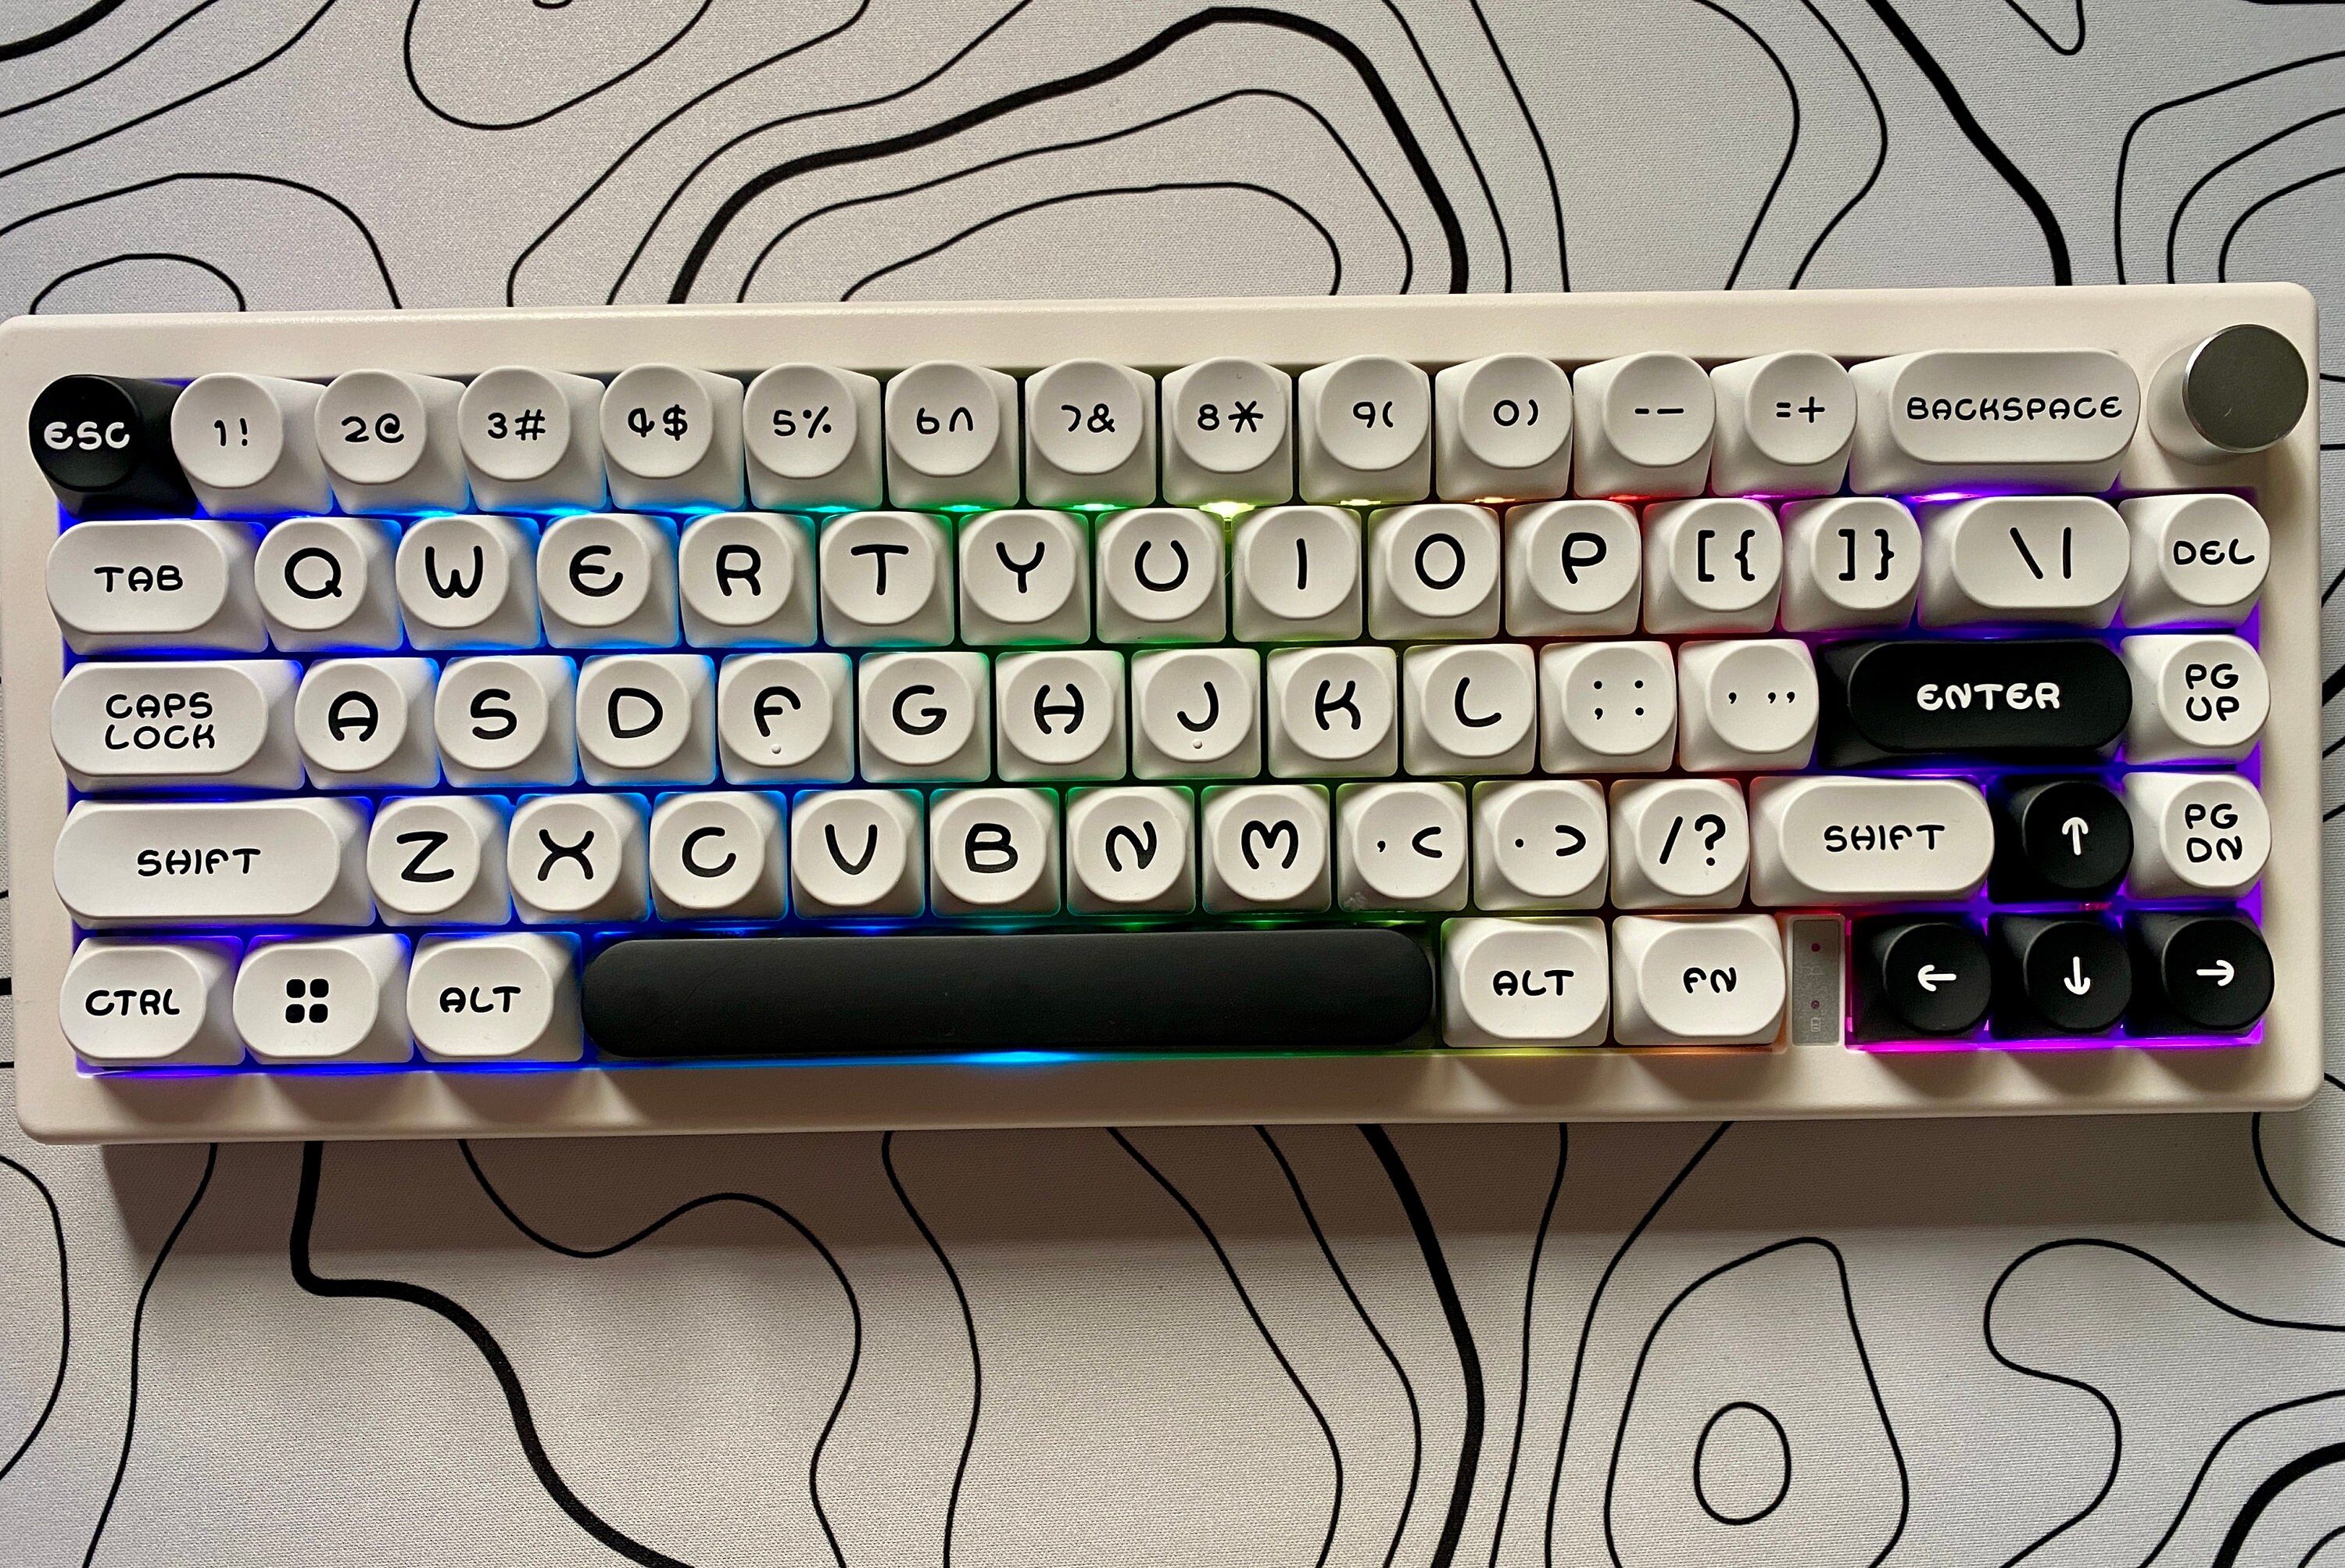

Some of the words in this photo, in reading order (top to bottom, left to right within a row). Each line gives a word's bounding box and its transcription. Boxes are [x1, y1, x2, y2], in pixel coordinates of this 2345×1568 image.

[341, 413, 405, 444] 2@
[487, 409, 546, 441] 3#
[628, 403, 688, 442] 4$
[772, 406, 832, 439] 5%
[1906, 396, 2122, 421] BACKSPACE
[44, 421, 131, 450] ESC
[284, 547, 342, 600] Q
[424, 545, 484, 599] W
[569, 545, 624, 597] E
[716, 544, 761, 596] R
[850, 543, 909, 596] T
[995, 541, 1045, 594] Y
[1134, 539, 1189, 592] U
[1414, 532, 1466, 590] O
[1561, 532, 1607, 585] P
[2173, 538, 2255, 565] DEL
[94, 564, 184, 592] TAB
[1917, 682, 2060, 711] ENTER
[2185, 663, 2239, 690] PG
[106, 691, 213, 719] CAPS
[328, 690, 379, 742] A
[470, 688, 517, 740] S
[607, 687, 664, 739] D
[754, 686, 801, 737] F
[892, 684, 947, 736] G
[1033, 683, 1084, 735] H
[1176, 681, 1219, 732] J
[1315, 679, 1361, 731] K
[1454, 677, 1502, 728] L
[2186, 696, 2239, 722] UP
[105, 724, 215, 750] LOCK
[1824, 824, 1946, 853] SHIFT
[2185, 803, 2239, 830] PG
[137, 848, 261, 877] SHIFT
[396, 831, 455, 883] Z
[537, 829, 595, 882] X
[682, 826, 736, 878] C
[824, 824, 878, 875] V
[965, 822, 1019, 874] B
[1105, 821, 1158, 872] N
[1241, 819, 1299, 870] M
[2186, 836, 2243, 863] DN
[85, 988, 181, 1016] CTRL
[439, 986, 521, 1013] ALT
[1492, 969, 1574, 997] ALT
[1683, 967, 1737, 994] FN
